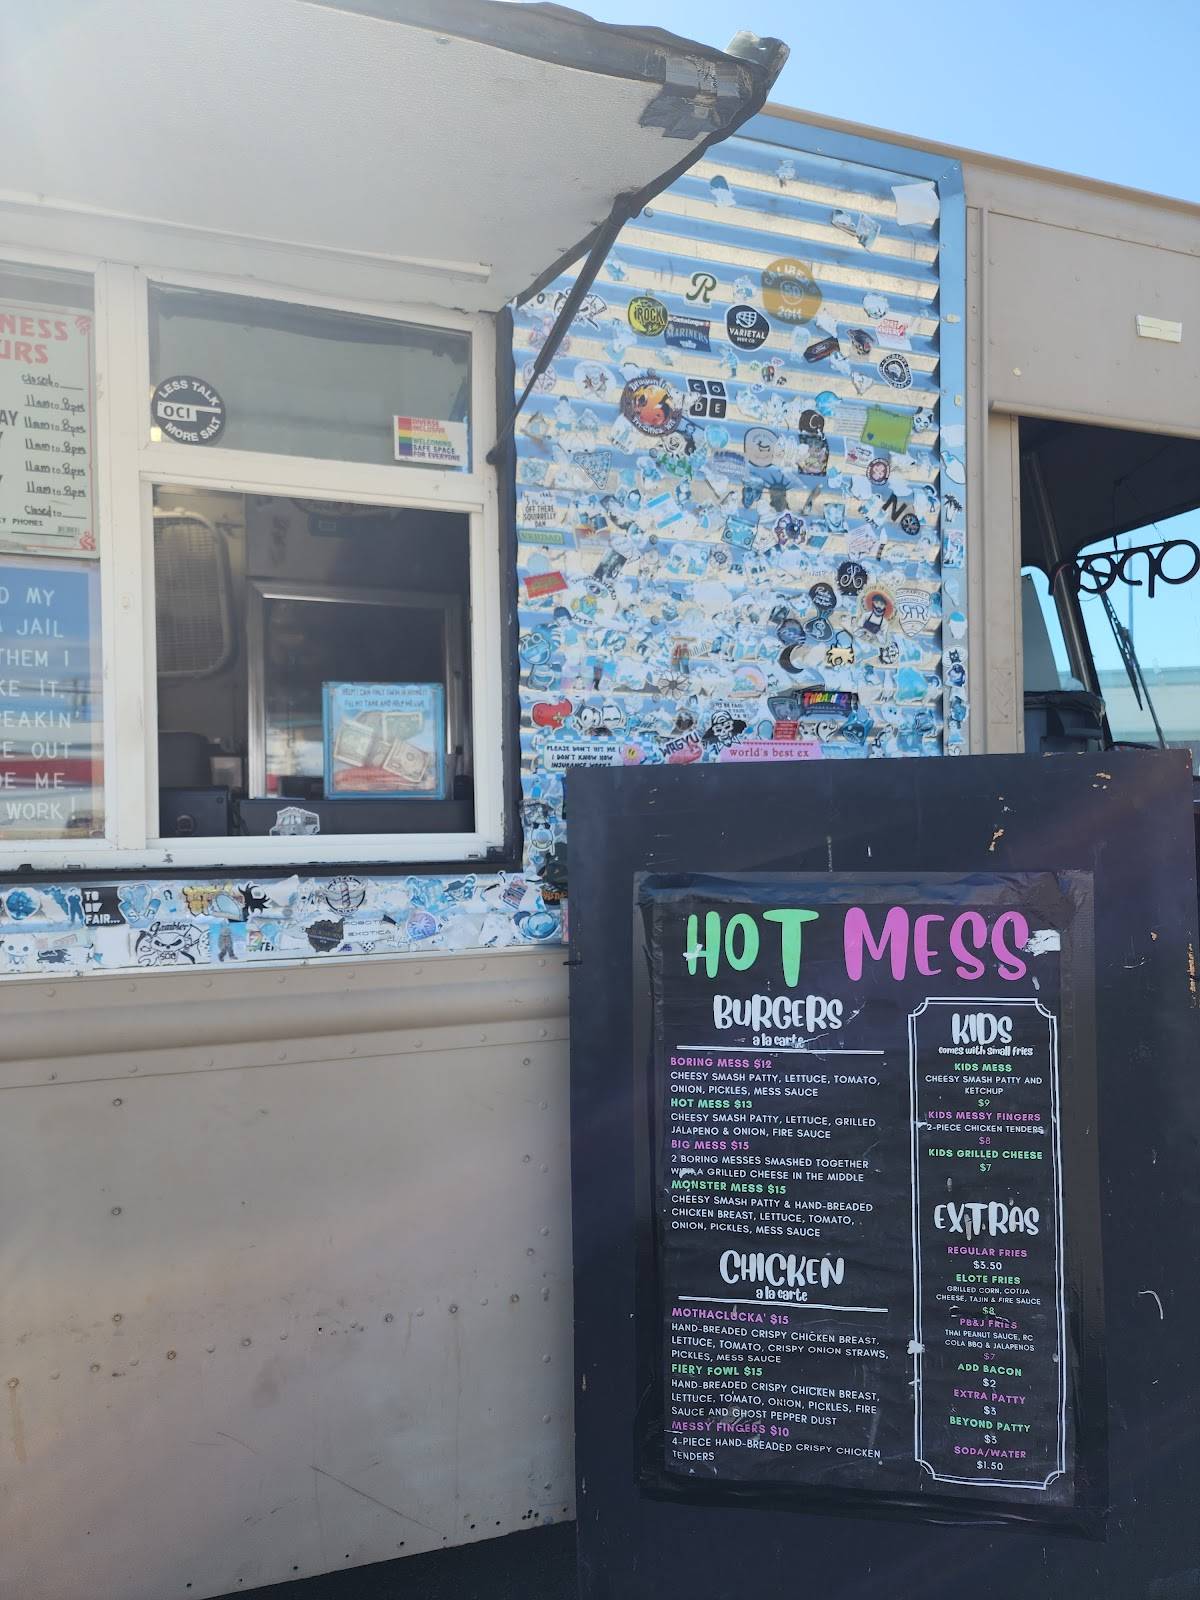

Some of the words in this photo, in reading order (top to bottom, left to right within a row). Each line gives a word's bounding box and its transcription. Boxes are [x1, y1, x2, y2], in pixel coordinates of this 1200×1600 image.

[686, 273, 717, 303] R
[729, 328, 766, 339] VARIETAL
[159, 380, 188, 398] LESS
[192, 381, 219, 406] TALK
[164, 406, 190, 419] OCI
[165, 422, 199, 441] MORE
[200, 417, 220, 439] SALT
[428, 453, 460, 461] EVERYONE
[26, 587, 55, 607] MY
[16, 618, 64, 638] JAIL
[65, 650, 69, 667] I
[40, 679, 65, 698] IT.
[0, 710, 80, 729] EAKIN'
[31, 742, 72, 759] OUT
[659, 731, 700, 757] WAGYU
[730, 749, 768, 757] world's
[772, 749, 795, 757] best
[35, 772, 65, 790] ME
[84, 891, 99, 900] TO
[150, 922, 188, 936] Gambler
[687, 909, 819, 988] HOT
[844, 907, 1031, 982] MESS
[713, 994, 843, 1032] BURGERS
[952, 1013, 1013, 1045] KIDS
[753, 1037, 759, 1046] a
[761, 1033, 772, 1046] la
[774, 1034, 805, 1048] carte
[938, 1047, 964, 1055] comes
[966, 1046, 986, 1055] with
[987, 1046, 1011, 1056] small
[1012, 1047, 1033, 1056] fries
[671, 1058, 713, 1066] BORING
[718, 1059, 749, 1068] MESS
[754, 1059, 772, 1069] $12
[954, 1063, 978, 1071] KIDS
[982, 1064, 1012, 1072] MESS
[670, 1072, 708, 1080] CHEESY
[712, 1073, 745, 1081] SMASH
[750, 1074, 782, 1083] PATTY,
[785, 1075, 830, 1084] LETTUCE,
[834, 1076, 880, 1085] TOMATO,
[671, 1085, 705, 1094] ONION,
[709, 1087, 750, 1096] PICKLES,
[754, 1088, 781, 1096] MESS
[784, 1088, 818, 1096] SAUCE
[671, 1099, 694, 1108] HOT
[698, 1100, 730, 1108] MESS
[734, 1100, 752, 1109] $13
[978, 1099, 990, 1107] $9
[929, 1111, 952, 1119] KIDS
[956, 1112, 992, 1120] MESSY
[997, 1113, 1041, 1121] FINGERS
[927, 1124, 961, 1132] 2-PIECE
[1006, 1125, 1044, 1133] TENDERS
[672, 1140, 690, 1149] BIG
[694, 1141, 726, 1150] MESS
[731, 1141, 749, 1150] $15
[979, 1137, 991, 1145] $8
[929, 1149, 952, 1157] KIDS
[957, 1150, 999, 1158] GRILLED
[1003, 1151, 1043, 1160] CHEESE
[980, 1163, 992, 1172] $7
[672, 1180, 726, 1191] MONSTER
[731, 1184, 763, 1192] MESS
[768, 1184, 786, 1194] $15
[934, 1201, 1039, 1236] EXTRAS
[948, 1247, 995, 1256] REGULAR
[999, 1249, 1027, 1258] FRIES
[720, 1250, 844, 1288] CHICKEN
[974, 1260, 1002, 1270] $3.50
[956, 1274, 988, 1283] ELOTE
[992, 1276, 1020, 1284] FRIES
[756, 1289, 763, 1298] a
[765, 1286, 775, 1300] la
[778, 1288, 808, 1302] carte
[672, 1308, 766, 1323] MOTHACLUCKA'
[770, 1314, 789, 1324] $15
[983, 1307, 995, 1315] $8
[960, 1318, 984, 1327] PB&J
[989, 1319, 1017, 1329] FRIES
[672, 1323, 747, 1336] HAND-BREADED
[751, 1330, 787, 1340] CRISPY
[791, 1332, 835, 1342] CHICKEN
[839, 1336, 879, 1345] BREAST,
[672, 1364, 702, 1375] FIERY
[707, 1367, 740, 1376] FOWL
[744, 1367, 762, 1376] $15
[958, 1363, 979, 1372] ADD
[983, 1365, 1022, 1376] BACON
[983, 1378, 996, 1388] $2
[954, 1389, 988, 1400] EXTRA
[992, 1392, 1025, 1404] PATTY
[984, 1406, 996, 1416] $3
[672, 1421, 711, 1432] MESSY
[717, 1423, 765, 1434] FINGERS
[770, 1427, 789, 1437] $10
[950, 1416, 993, 1429] BEYOND
[997, 1422, 1031, 1432] PATTY
[984, 1435, 997, 1444] $3
[954, 1446, 1026, 1458] SODA/WATER
[977, 1460, 1003, 1471] $1.50
